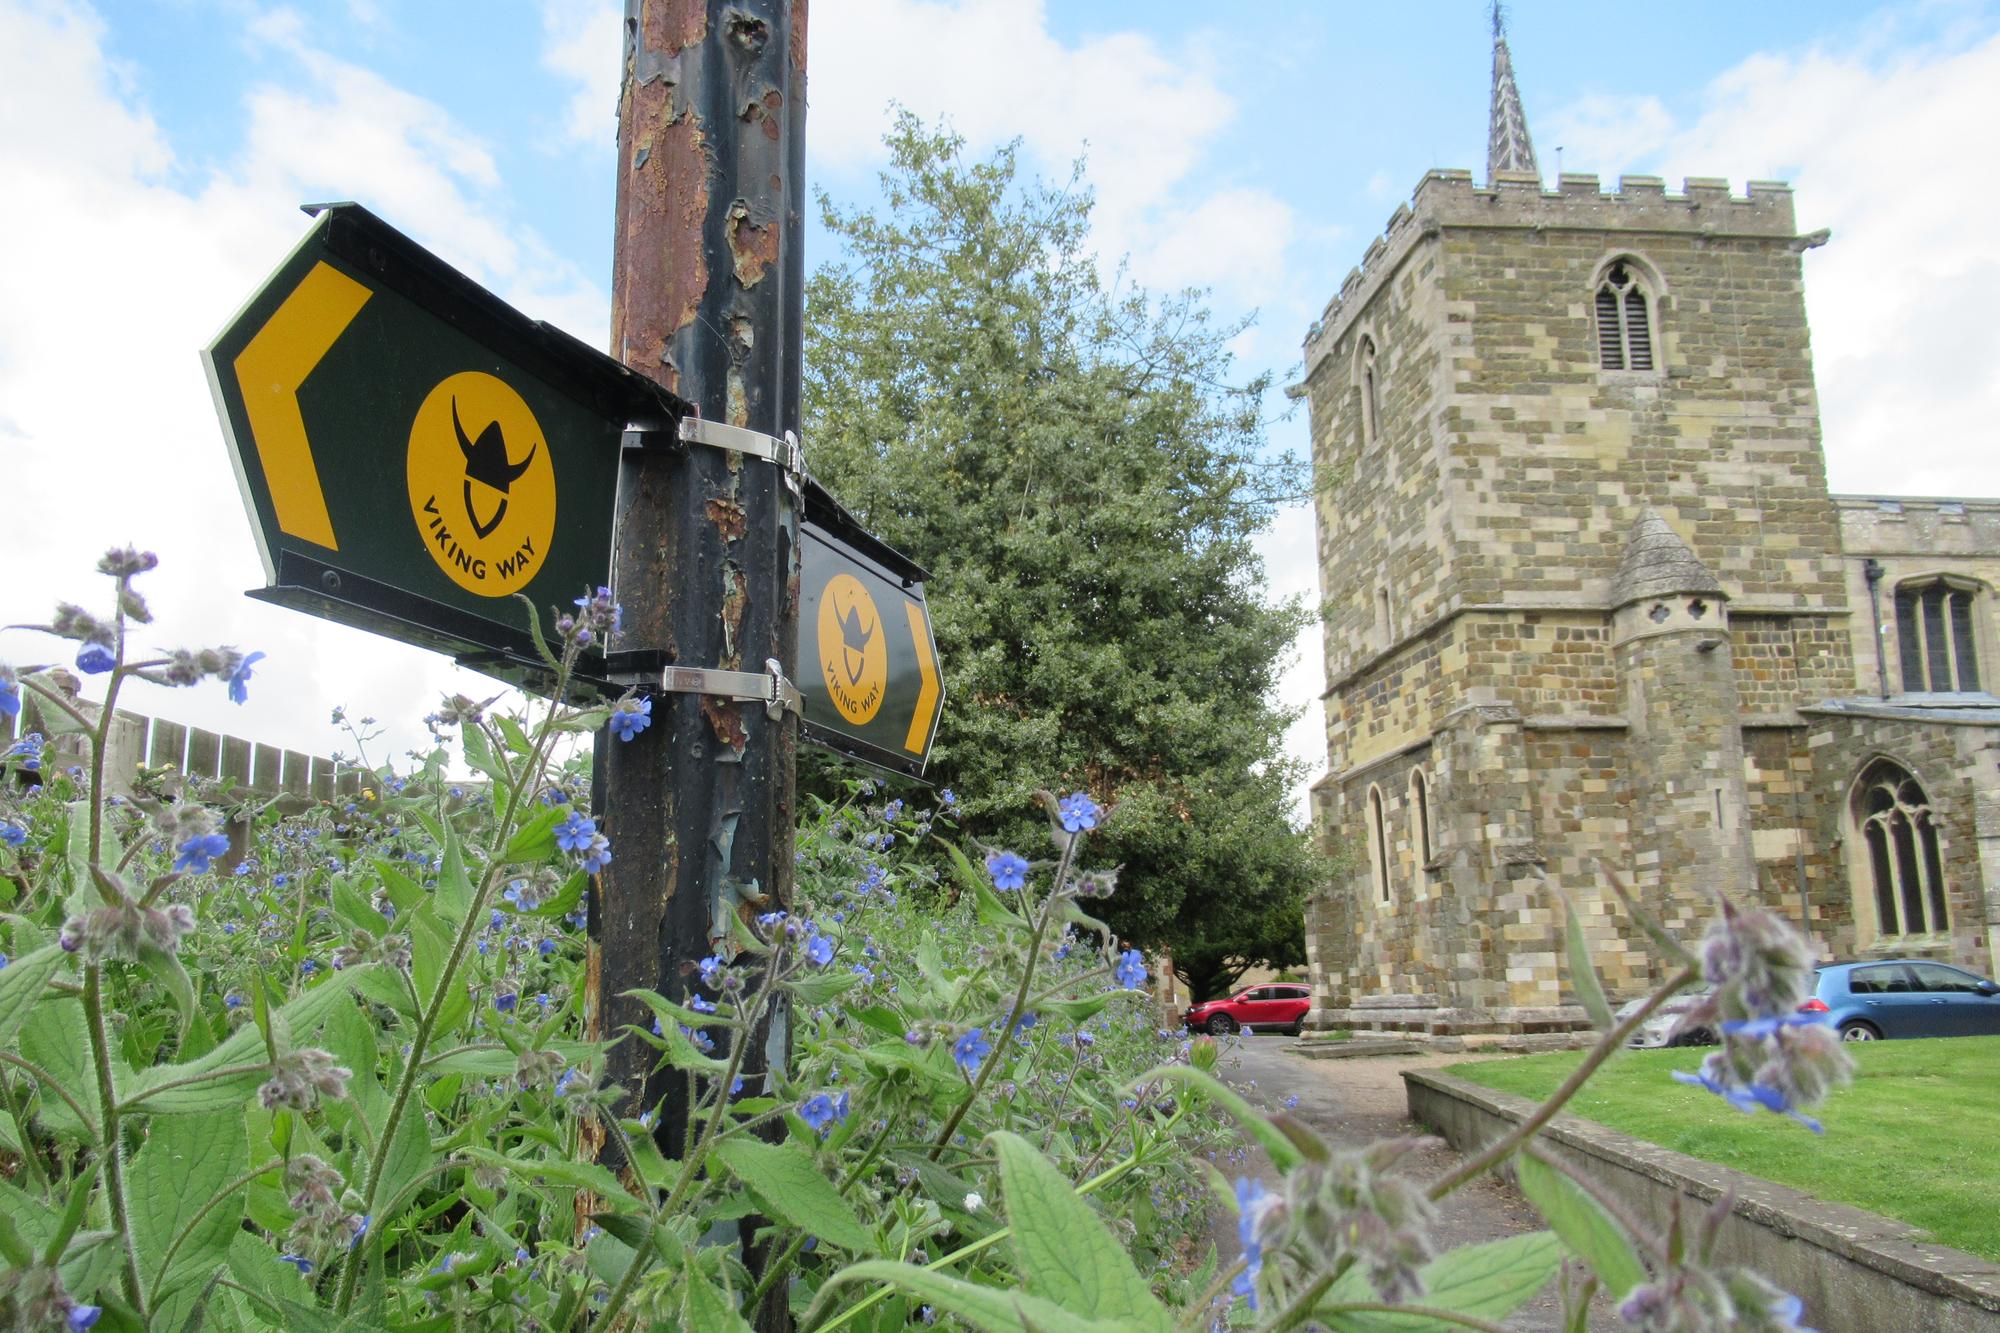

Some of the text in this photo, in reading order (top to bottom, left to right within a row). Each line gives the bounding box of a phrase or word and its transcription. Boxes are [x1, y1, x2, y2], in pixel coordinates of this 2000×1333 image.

[423, 495, 536, 580] VIKING WAY
[827, 661, 880, 714] VIKING WAY
